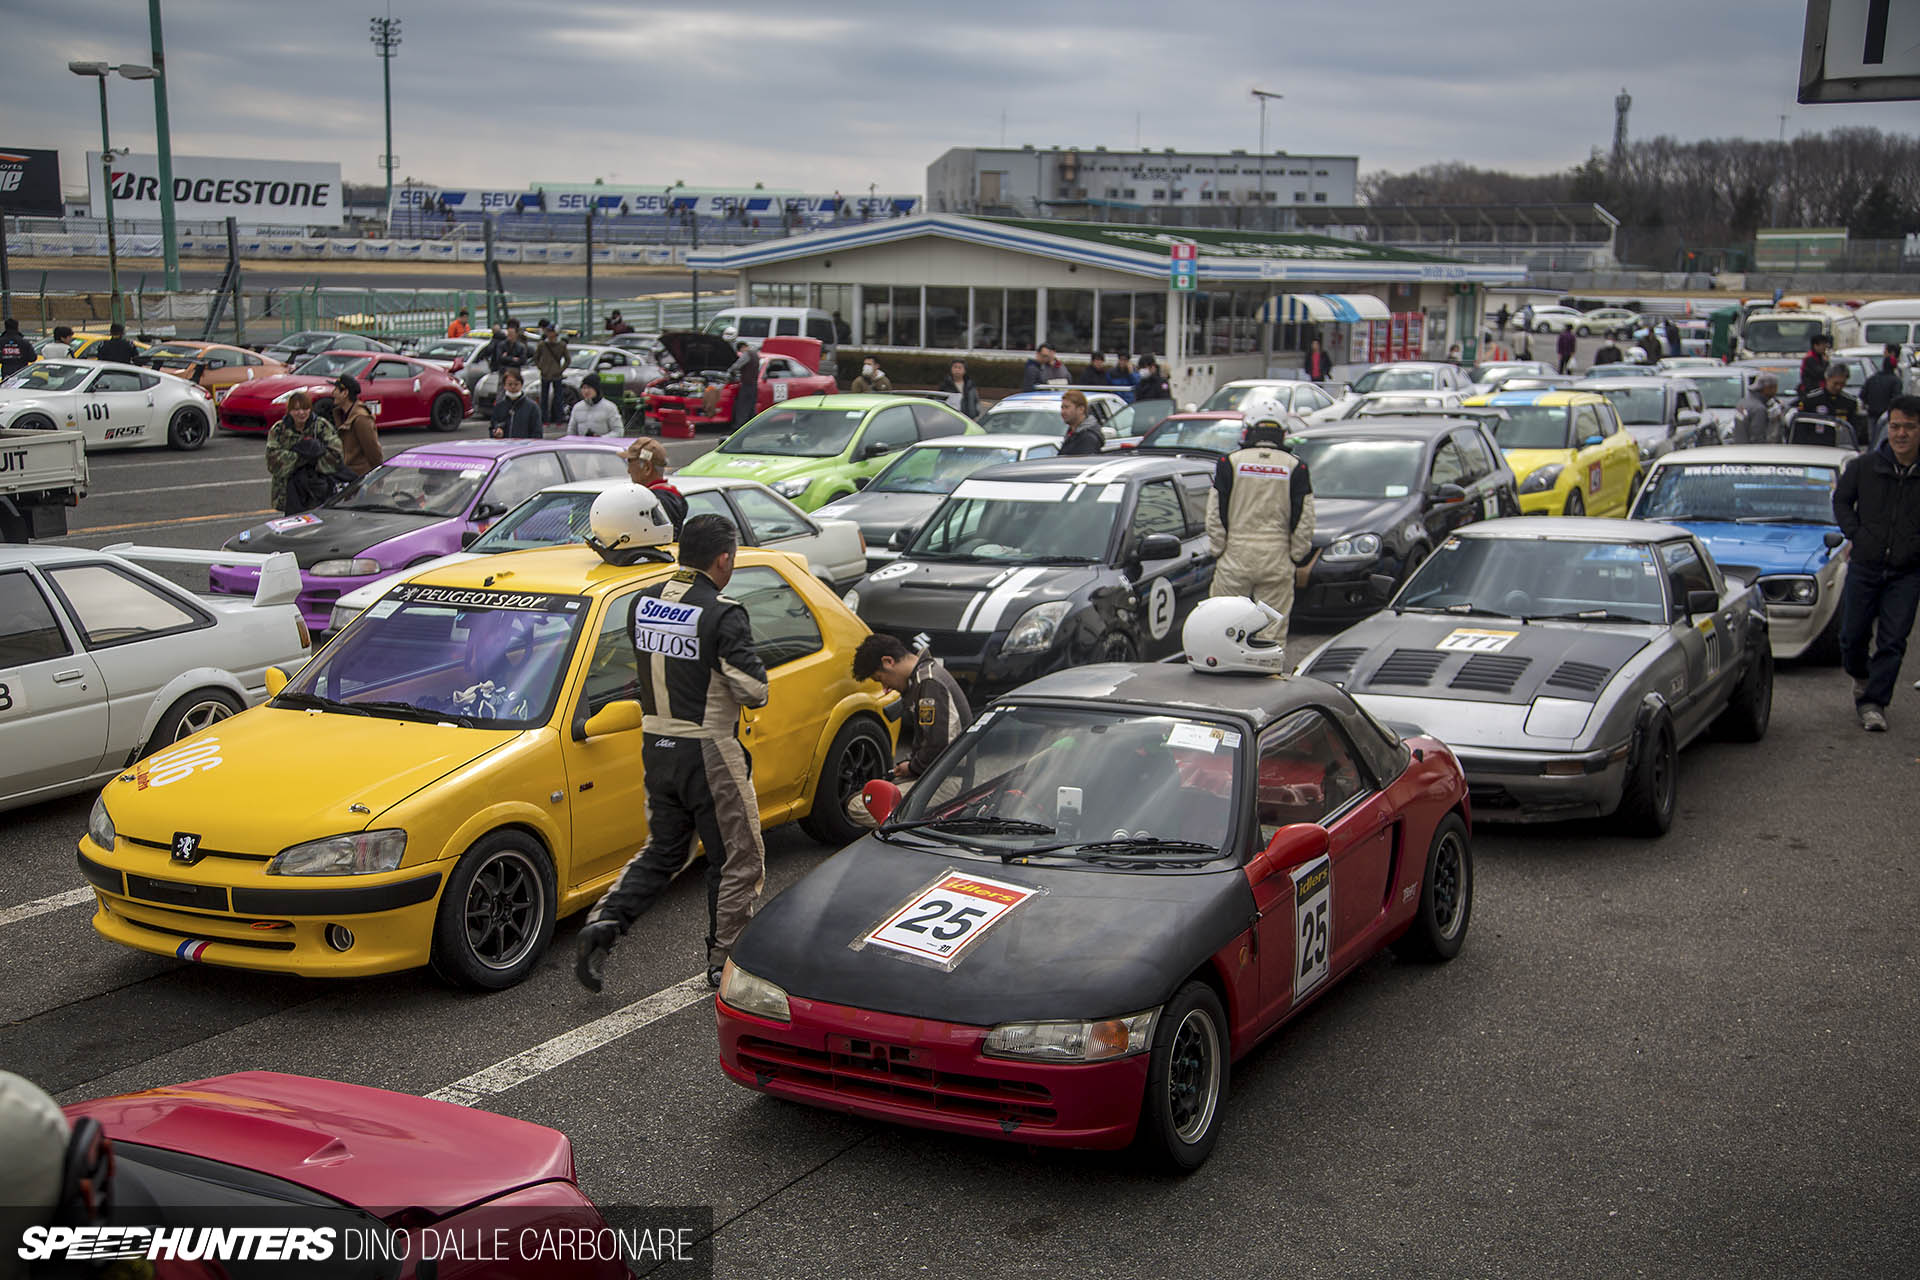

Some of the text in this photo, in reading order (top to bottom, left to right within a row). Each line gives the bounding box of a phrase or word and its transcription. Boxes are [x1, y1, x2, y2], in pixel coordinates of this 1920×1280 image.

[111, 172, 331, 207] BRDGESTONE
[480, 192, 520, 207] SEV
[559, 194, 597, 209] SEV
[83, 403, 109, 421] 101
[641, 600, 696, 623] Speed
[1156, 588, 1168, 624] 2
[635, 628, 697, 658] PAULOS
[1448, 634, 1509, 649] 777
[149, 736, 223, 787] 106
[945, 879, 1017, 903] idlers
[1299, 868, 1328, 897] idlers
[895, 900, 988, 941] 25
[1301, 900, 1327, 977] 25
